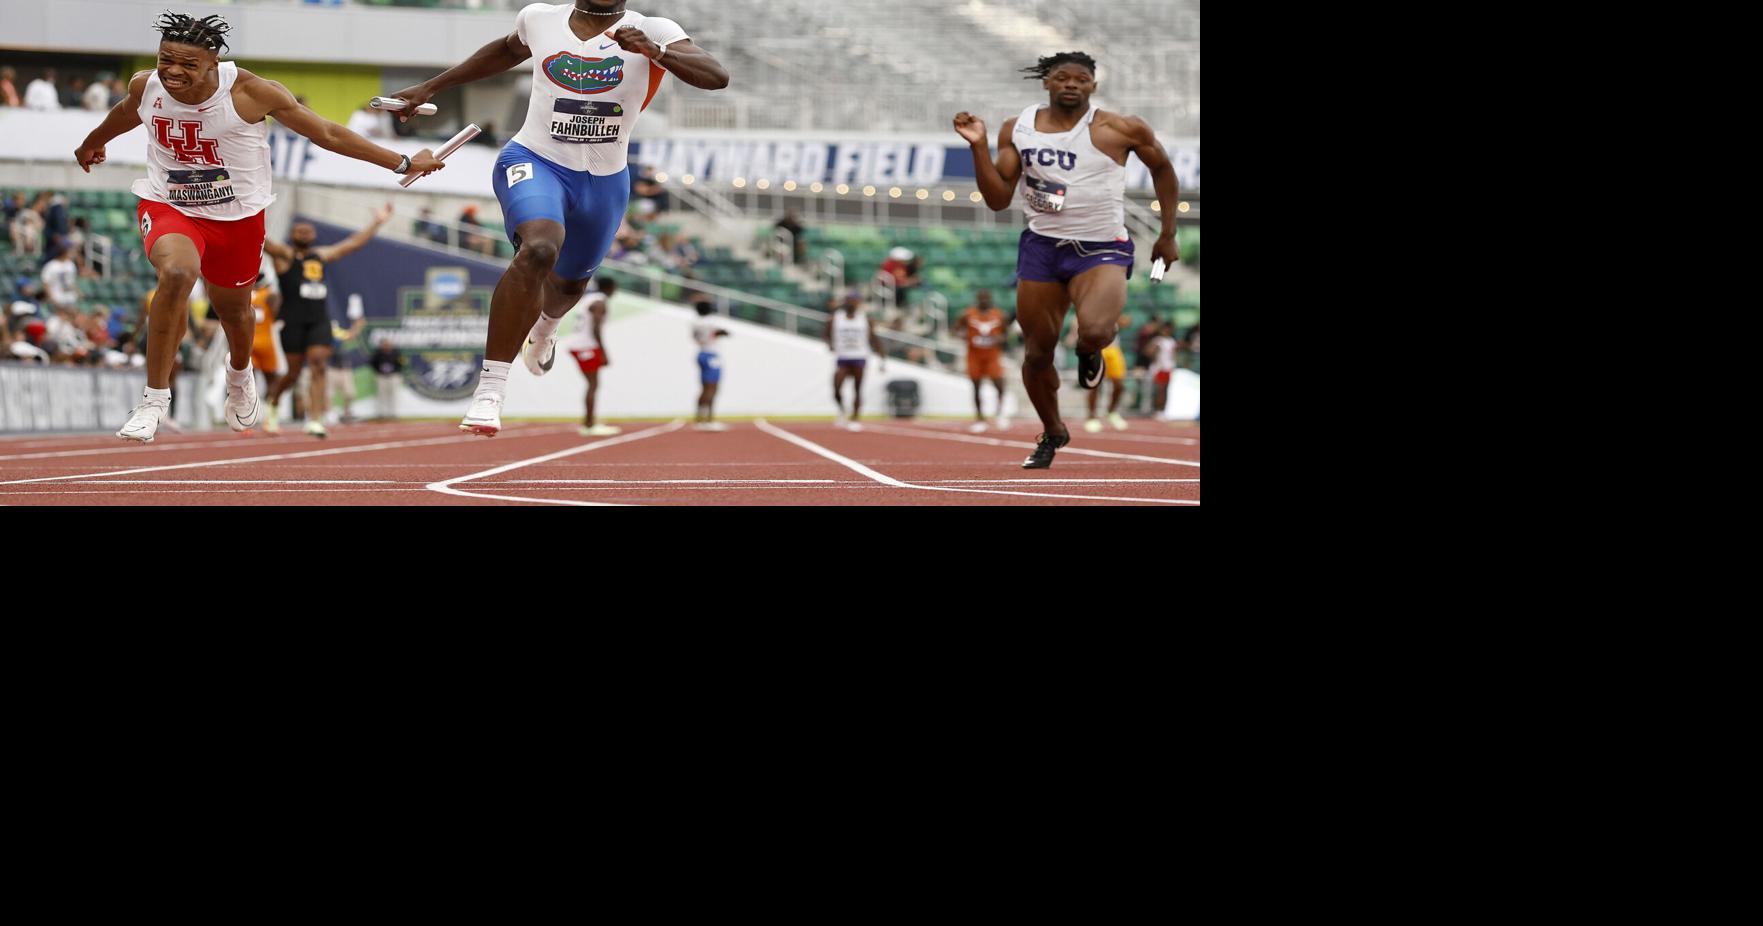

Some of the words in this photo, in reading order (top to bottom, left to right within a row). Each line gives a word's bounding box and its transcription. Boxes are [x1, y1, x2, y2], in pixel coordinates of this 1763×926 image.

[569, 115, 605, 125] JOSEPH
[551, 121, 620, 137] FAHNBULLEH
[637, 139, 828, 183] HAYWARD
[832, 146, 946, 185] FIELD
[1021, 148, 1077, 171] TCU
[512, 164, 527, 183] 5
[169, 185, 234, 200] MASWANGANYI
